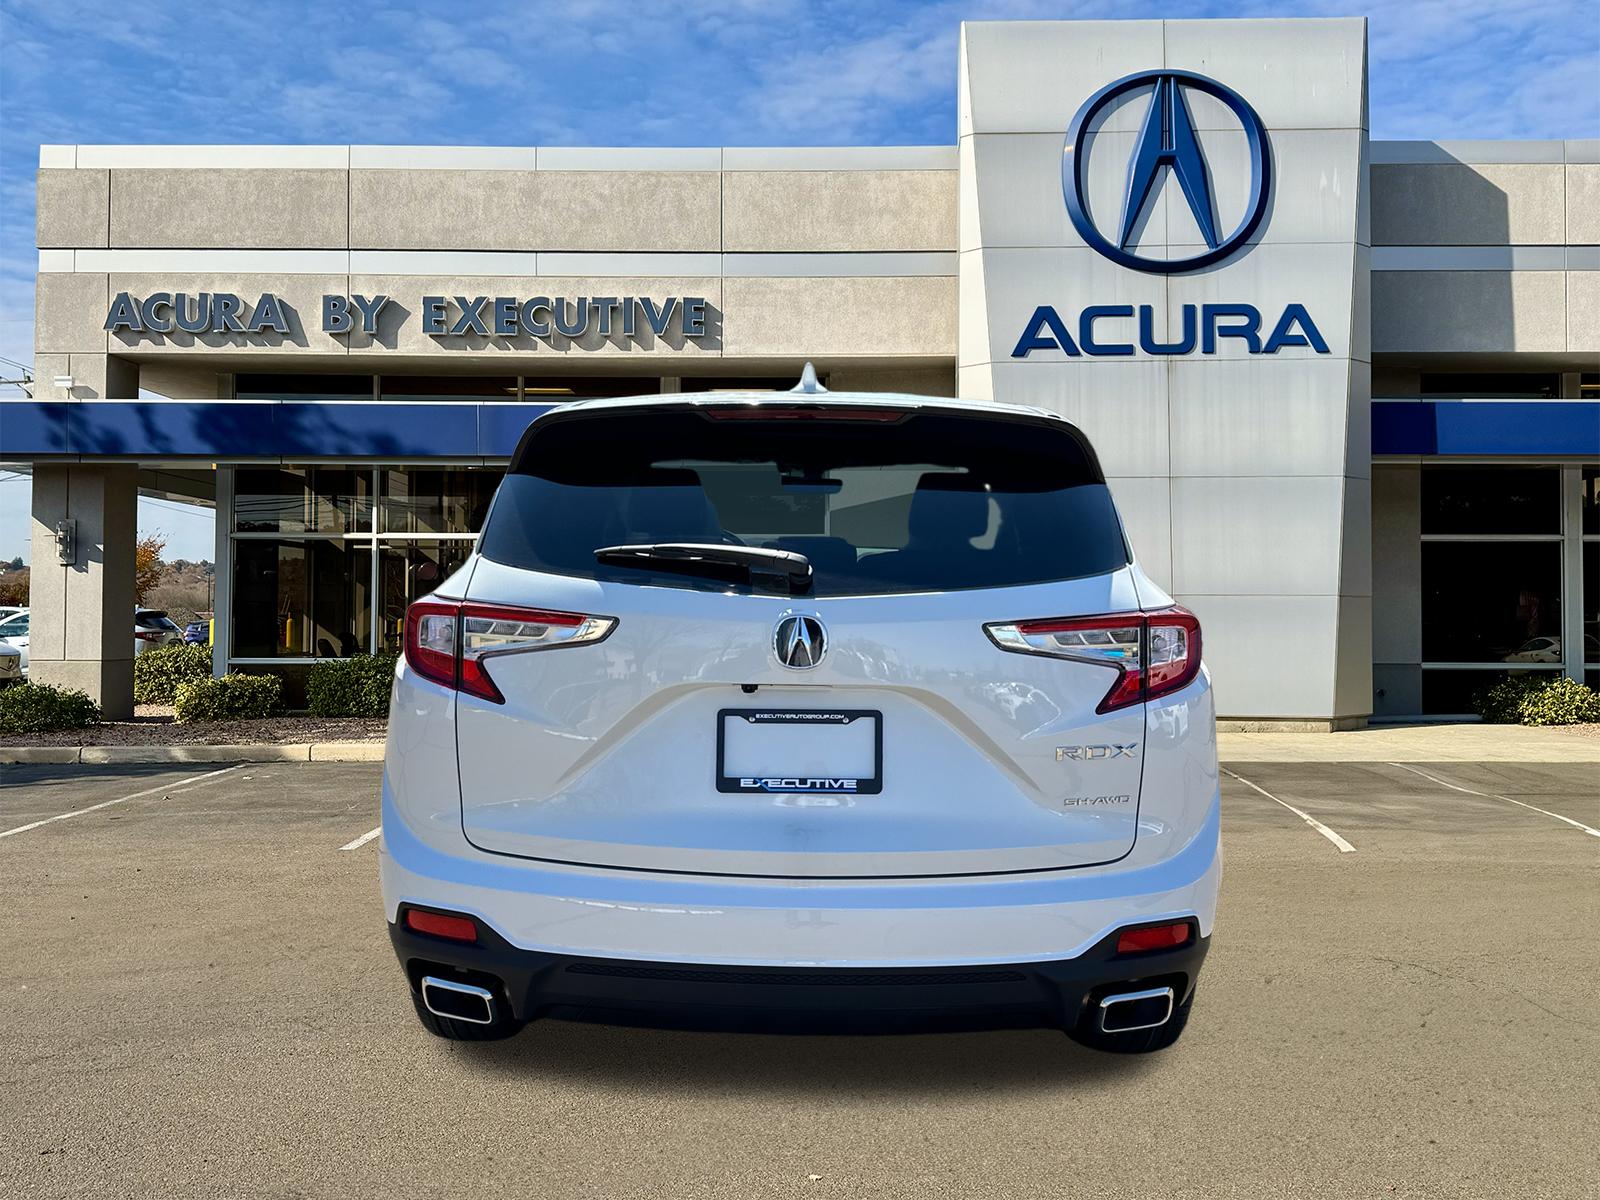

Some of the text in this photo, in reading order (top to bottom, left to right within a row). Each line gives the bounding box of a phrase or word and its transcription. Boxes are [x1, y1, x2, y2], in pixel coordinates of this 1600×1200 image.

[103, 292, 706, 336] ACURA BY EXECUTIVE
[1011, 304, 1332, 357] ACURA
[1055, 743, 1138, 762] RDX
[740, 778, 857, 790] EXECUTIVE
[1063, 795, 1130, 806] SH-AWD
